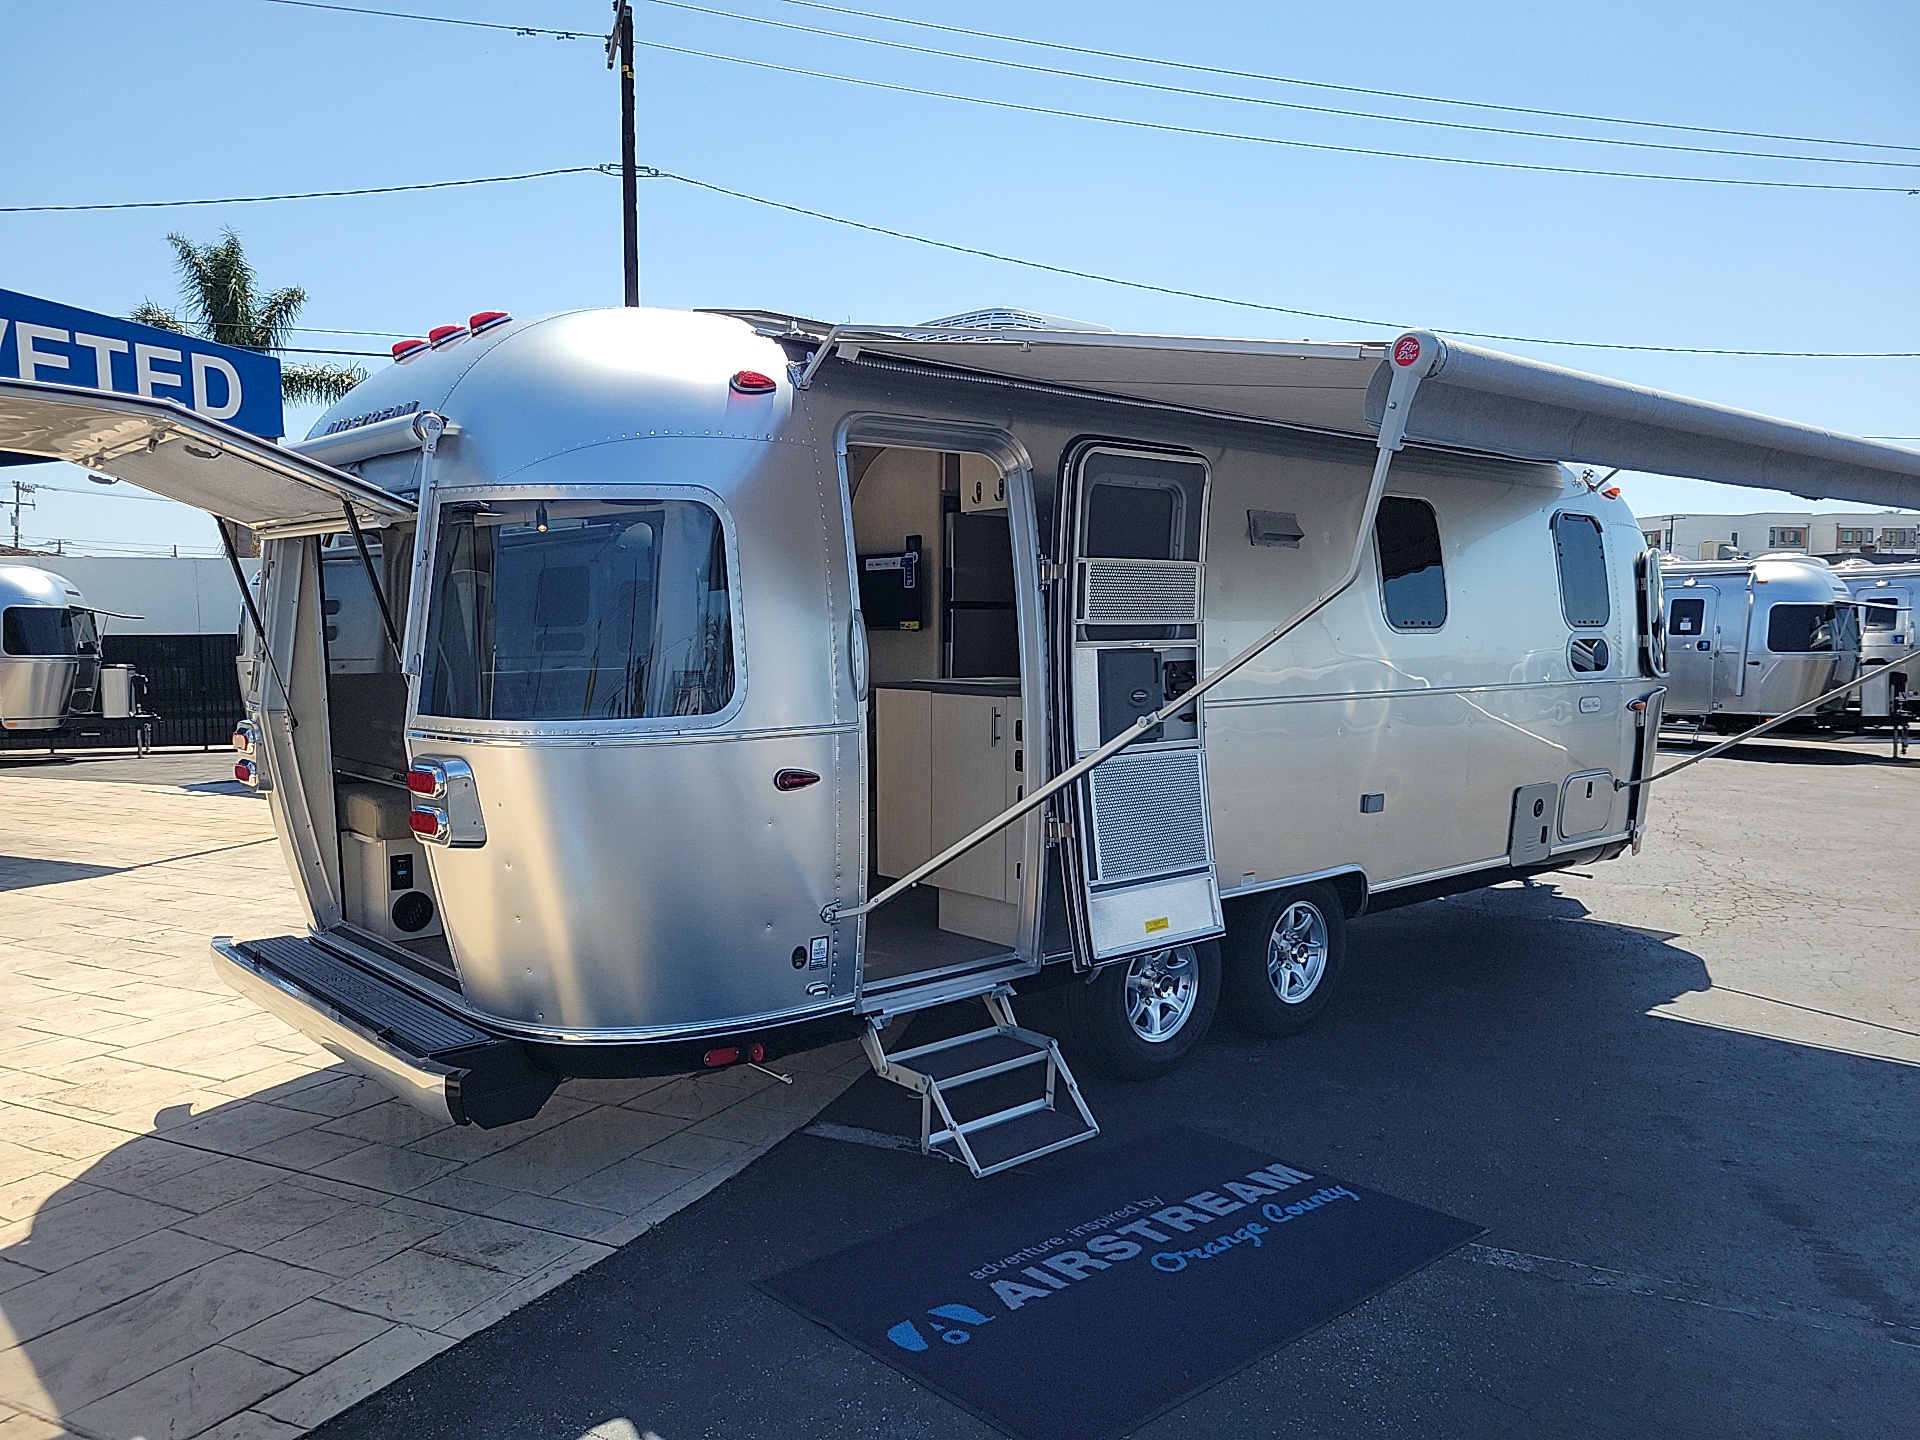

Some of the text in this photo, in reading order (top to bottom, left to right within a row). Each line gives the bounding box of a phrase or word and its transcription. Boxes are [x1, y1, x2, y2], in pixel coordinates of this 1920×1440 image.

[0, 318, 243, 420] ETED
[1396, 350, 1417, 360] Dee
[1400, 341, 1419, 353] Zip
[325, 400, 421, 435] AIRSTREAM
[969, 1195, 1166, 1280] adventure, inspired by
[989, 1163, 1314, 1310] AIRSTREAM
[1151, 1184, 1361, 1272] Orange County
